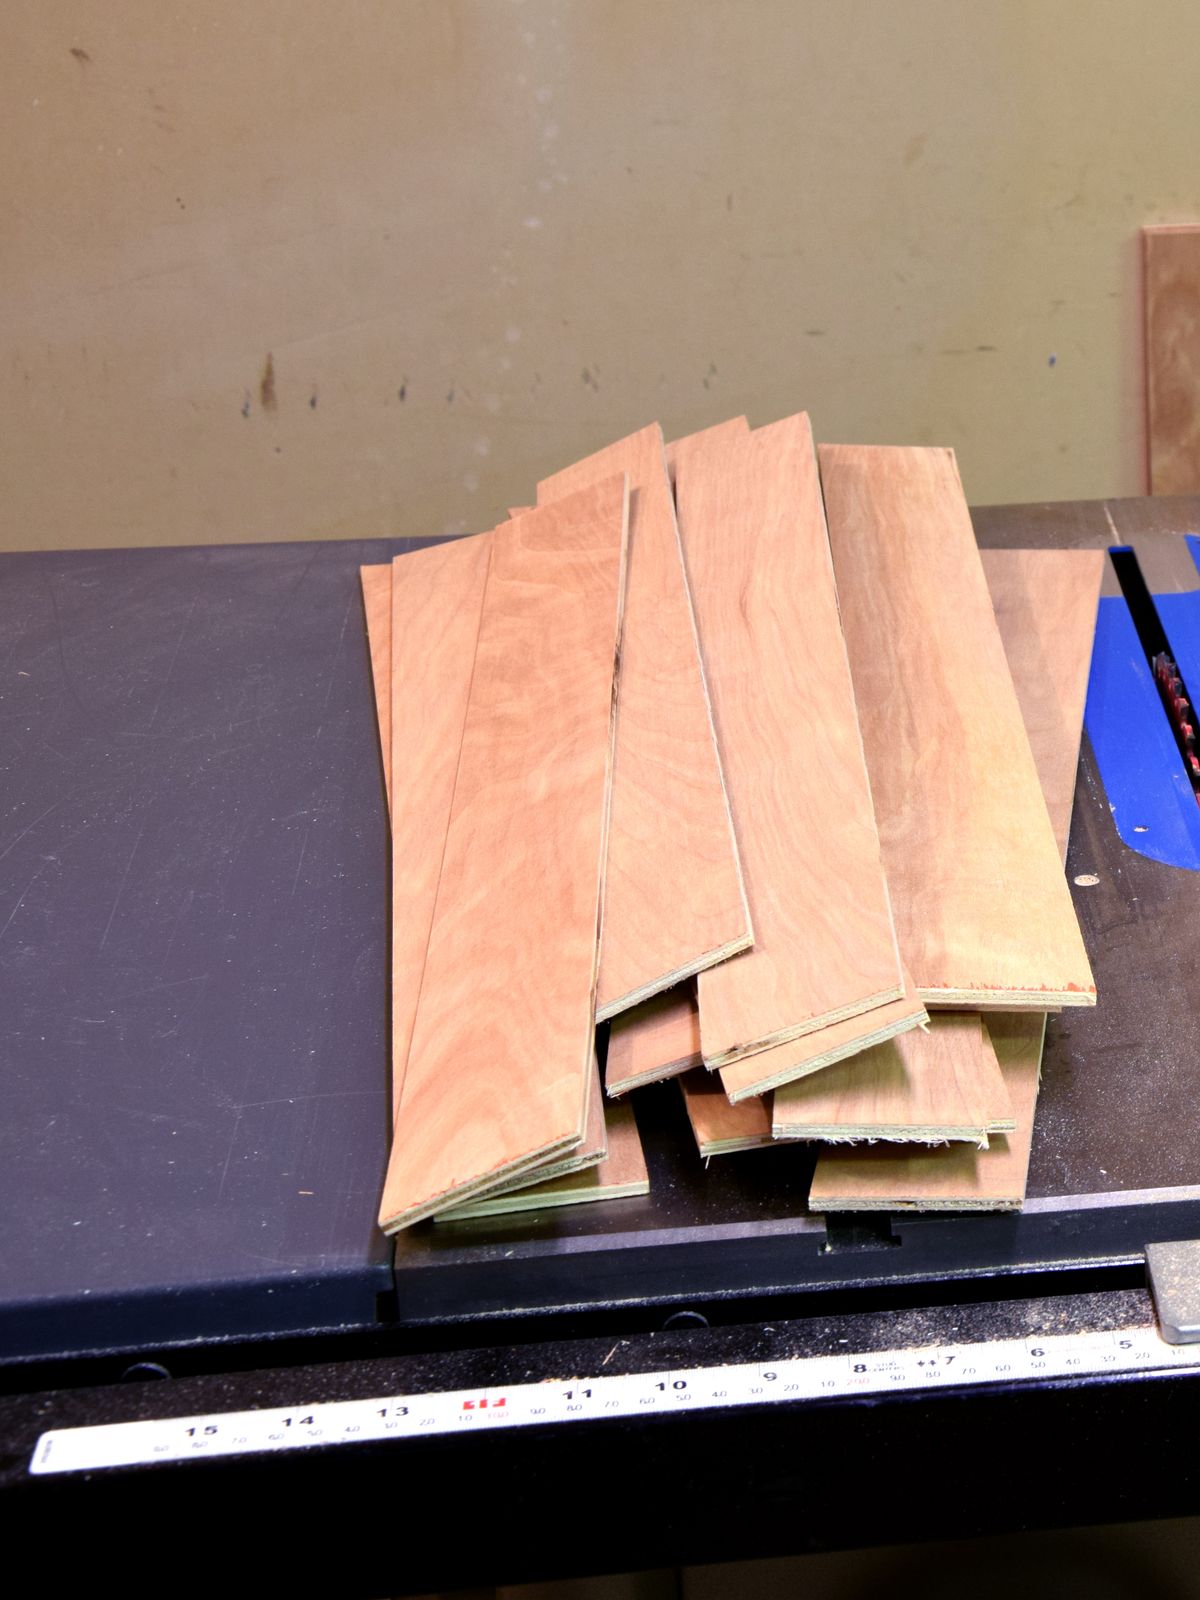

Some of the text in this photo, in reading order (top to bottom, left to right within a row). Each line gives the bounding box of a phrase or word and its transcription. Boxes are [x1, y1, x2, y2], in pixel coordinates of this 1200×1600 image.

[1031, 1348, 1045, 1357] 6
[1119, 1340, 1133, 1350] 5
[185, 1425, 218, 1437] 15
[282, 1416, 314, 1427] 14
[377, 1406, 409, 1418] 13
[563, 1389, 592, 1400] 11
[655, 1380, 687, 1391] 10
[763, 1372, 777, 1381] 9
[853, 1364, 867, 1373] 8
